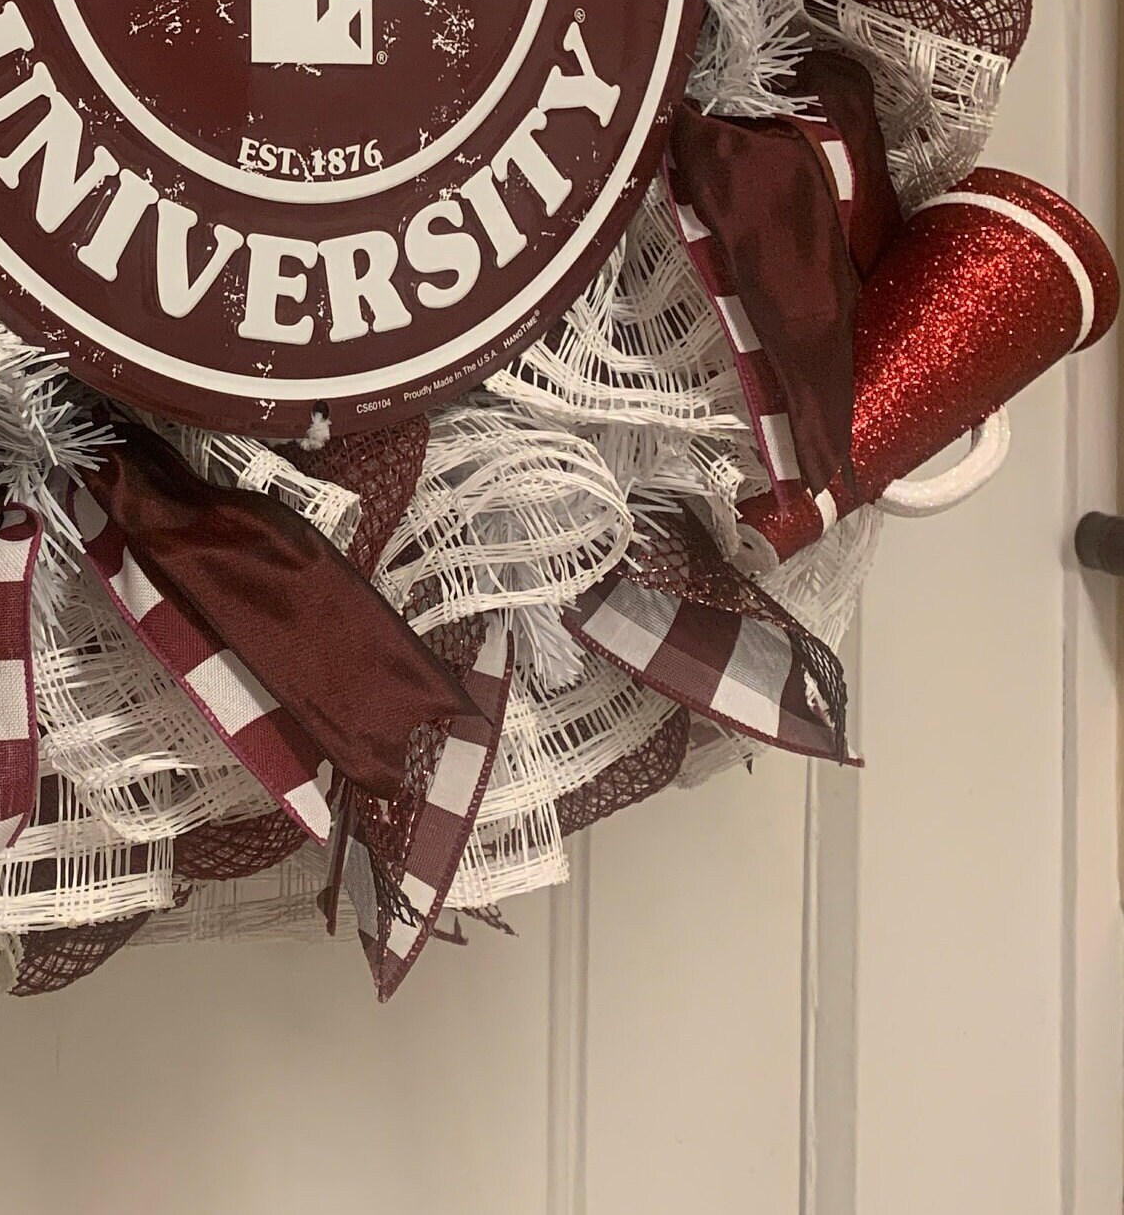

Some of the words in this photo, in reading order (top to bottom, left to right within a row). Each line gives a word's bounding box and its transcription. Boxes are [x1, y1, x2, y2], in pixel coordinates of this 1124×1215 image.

[237, 137, 300, 175] EST.
[311, 139, 383, 177] 1876
[403, 385, 433, 402] Proudly
[432, 375, 455, 392] Made
[454, 371, 463, 380] In
[462, 363, 478, 375] The
[356, 398, 392, 415] CS60104
